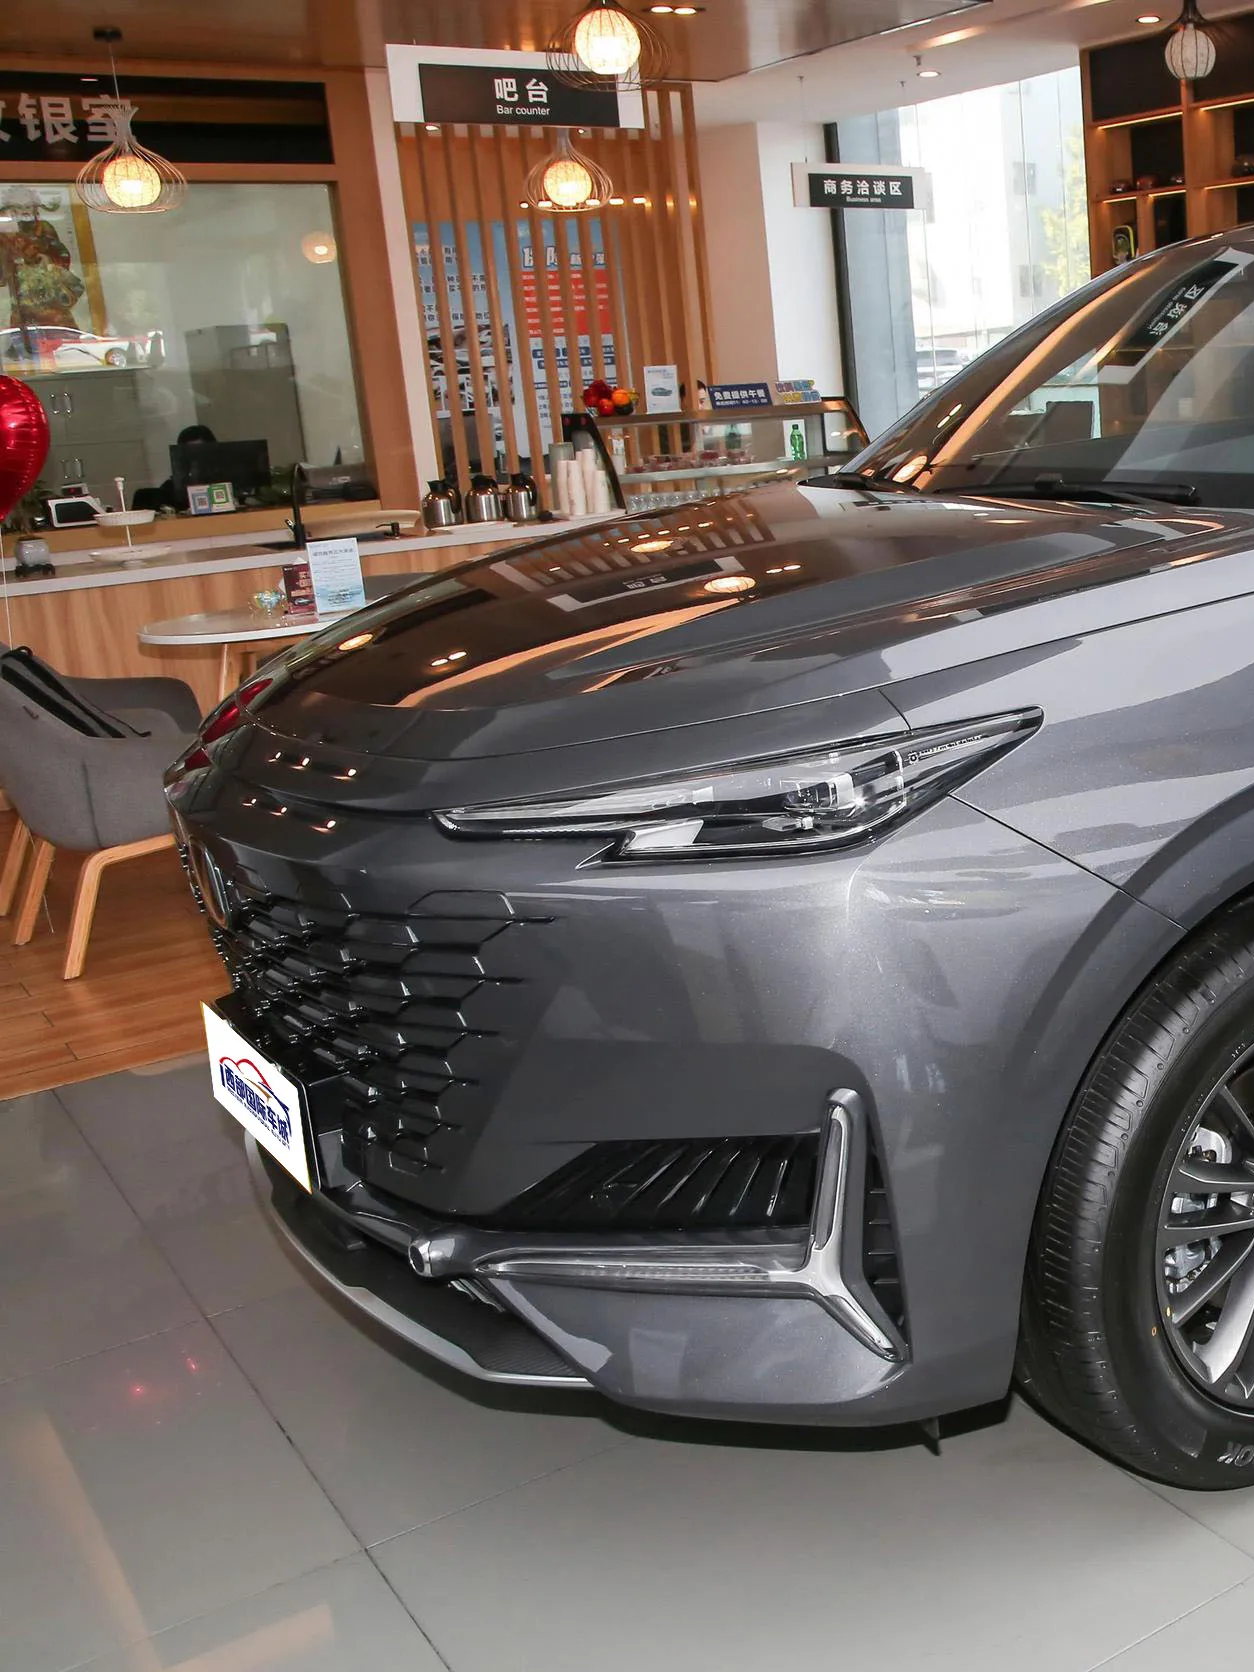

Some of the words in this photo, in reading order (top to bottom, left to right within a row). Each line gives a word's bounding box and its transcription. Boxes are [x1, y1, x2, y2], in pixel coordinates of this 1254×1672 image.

[494, 78, 549, 103] 吧台
[496, 104, 513, 115] Bar
[515, 106, 550, 115] counter
[823, 179, 903, 196] 商务洽谈区
[224, 1063, 290, 1144] 西部国际车城
